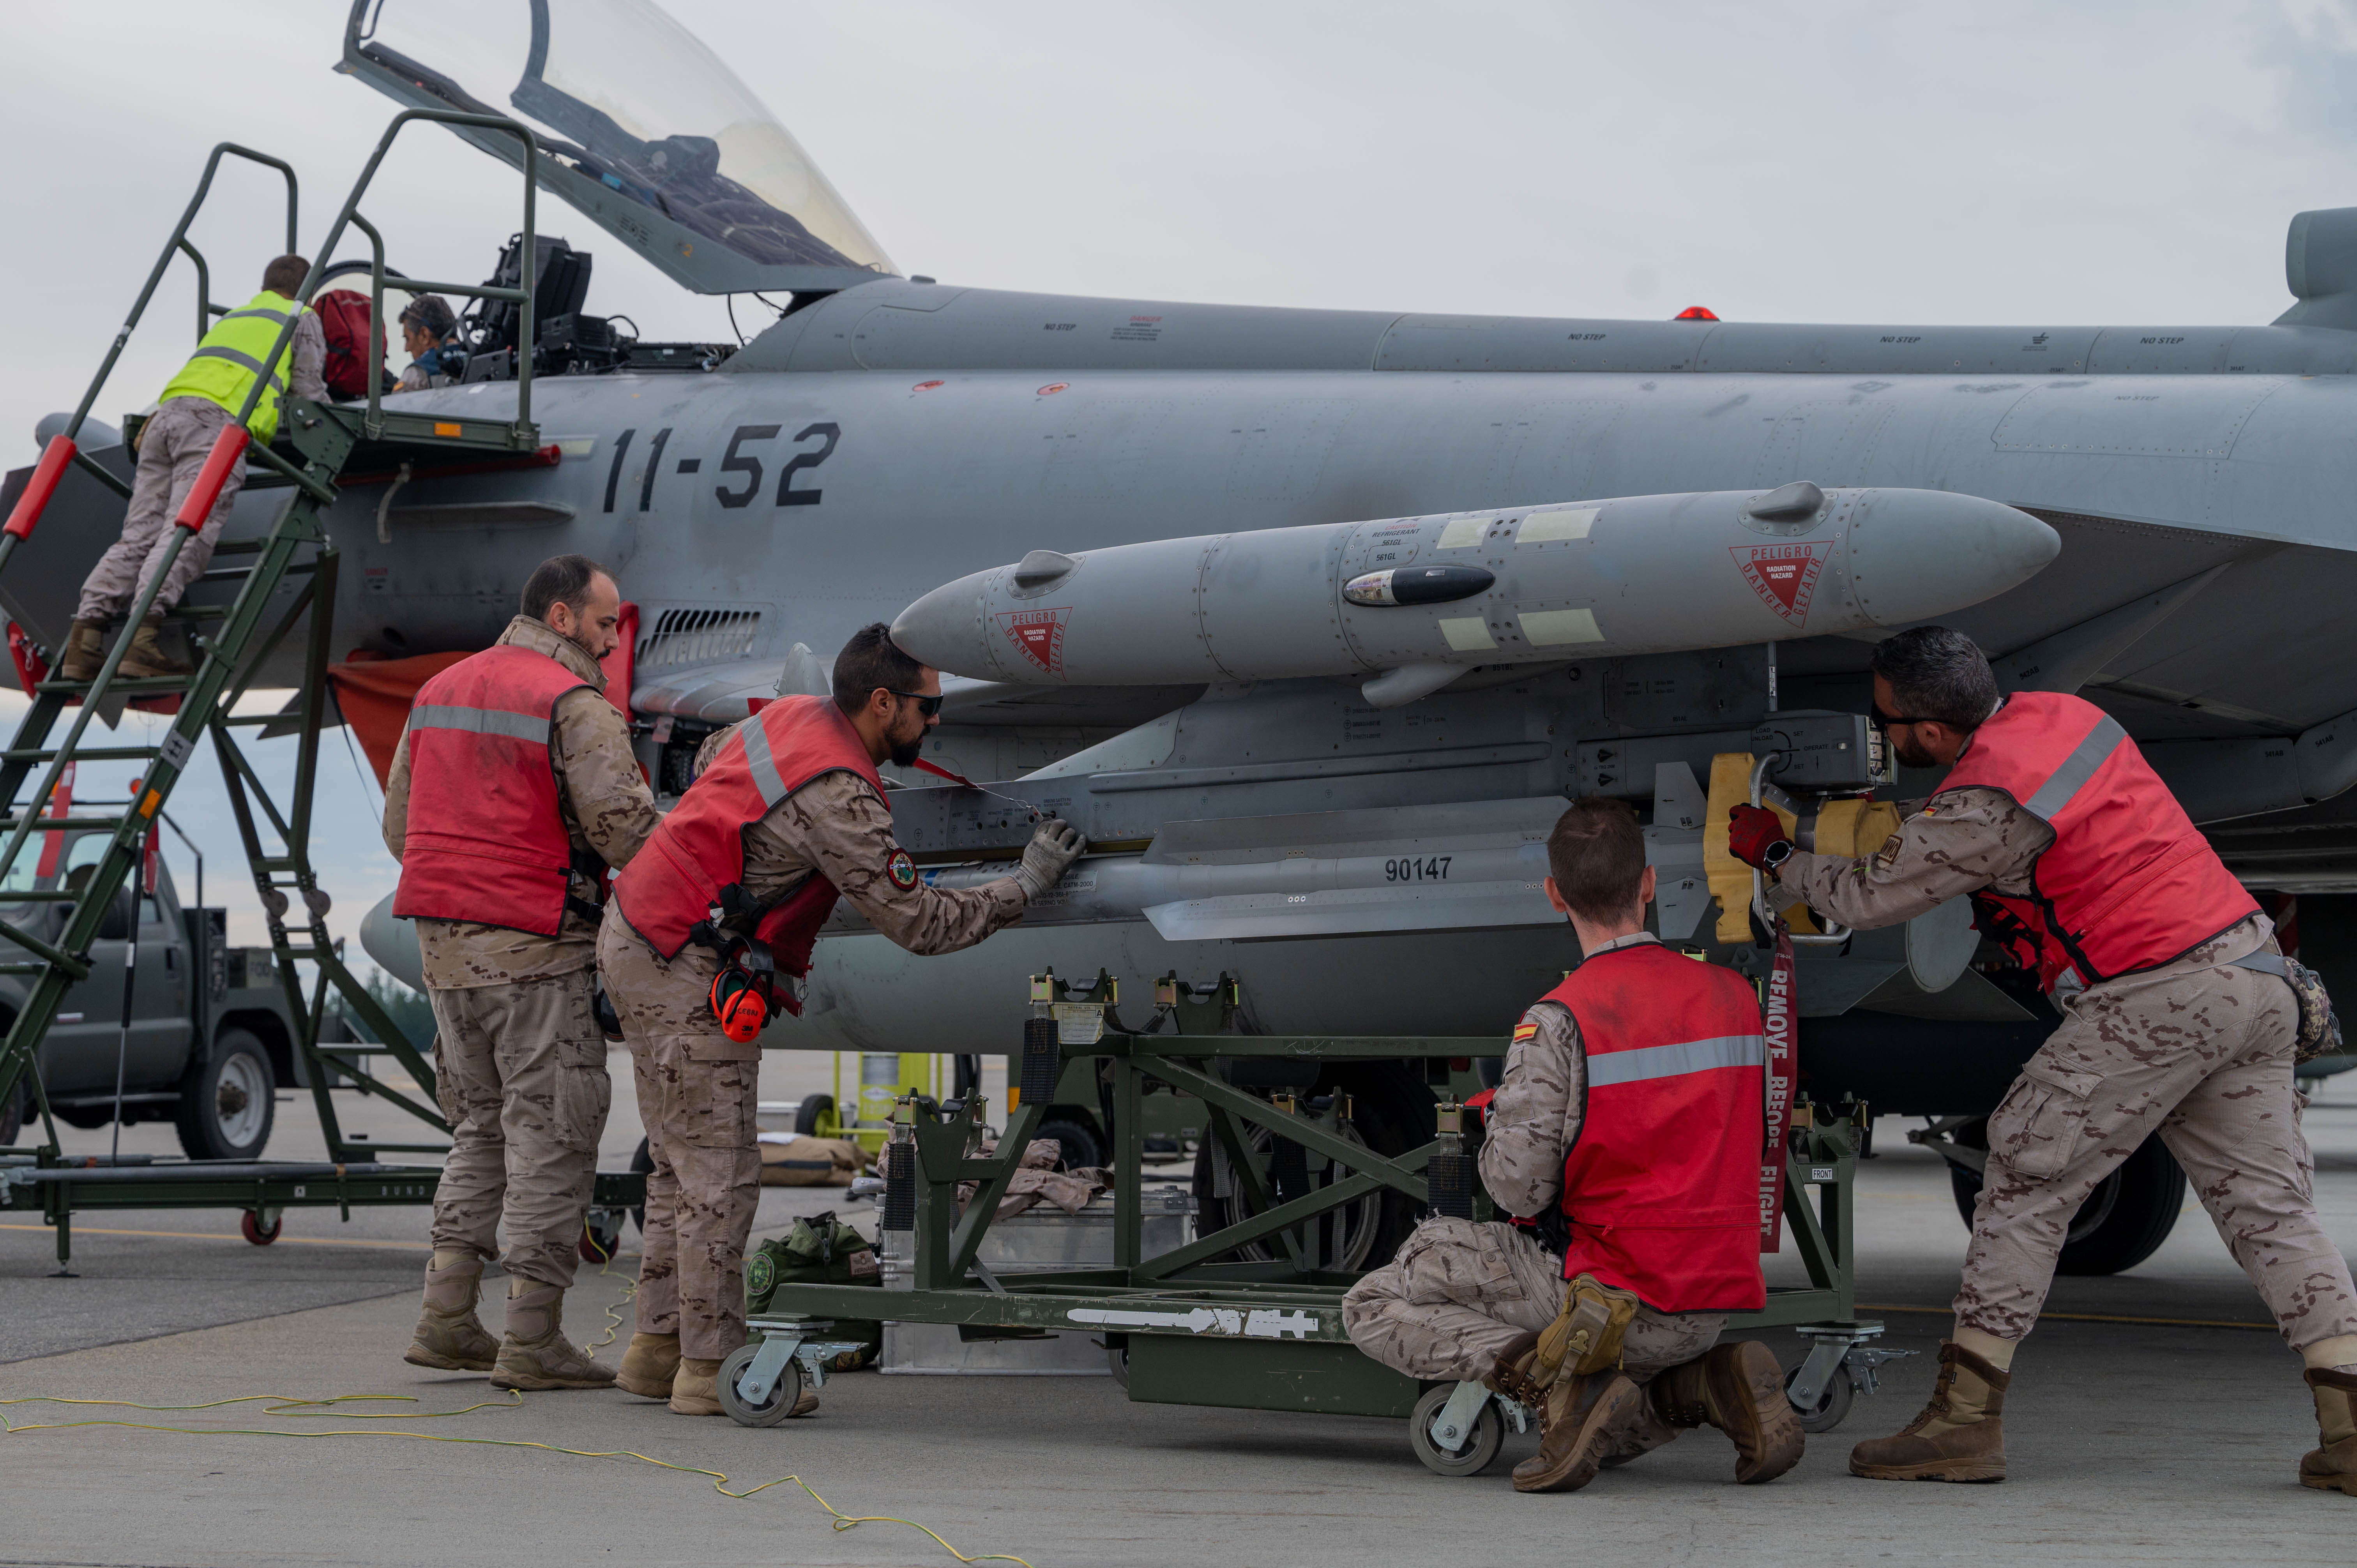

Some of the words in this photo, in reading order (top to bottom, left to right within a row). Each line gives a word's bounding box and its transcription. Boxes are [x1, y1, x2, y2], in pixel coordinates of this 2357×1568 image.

[603, 422, 841, 513] 11-52
[1372, 529, 1421, 537] REFRIGERANT
[1376, 553, 1396, 561] 561GL
[1751, 546, 1812, 560] PELIGRO
[1742, 562, 1792, 618] DANGER
[1793, 558, 1822, 615] GEFAHR
[1012, 611, 1056, 625] PELIGRO
[1007, 627, 1052, 674] DANGER
[1051, 622, 1064, 672] GEFAHR
[1385, 856, 1452, 882] 90147
[1767, 970, 1788, 1059] REMOVE
[1767, 1076, 1788, 1148] BEFORE
[1760, 1166, 1777, 1236] FLIGHT
